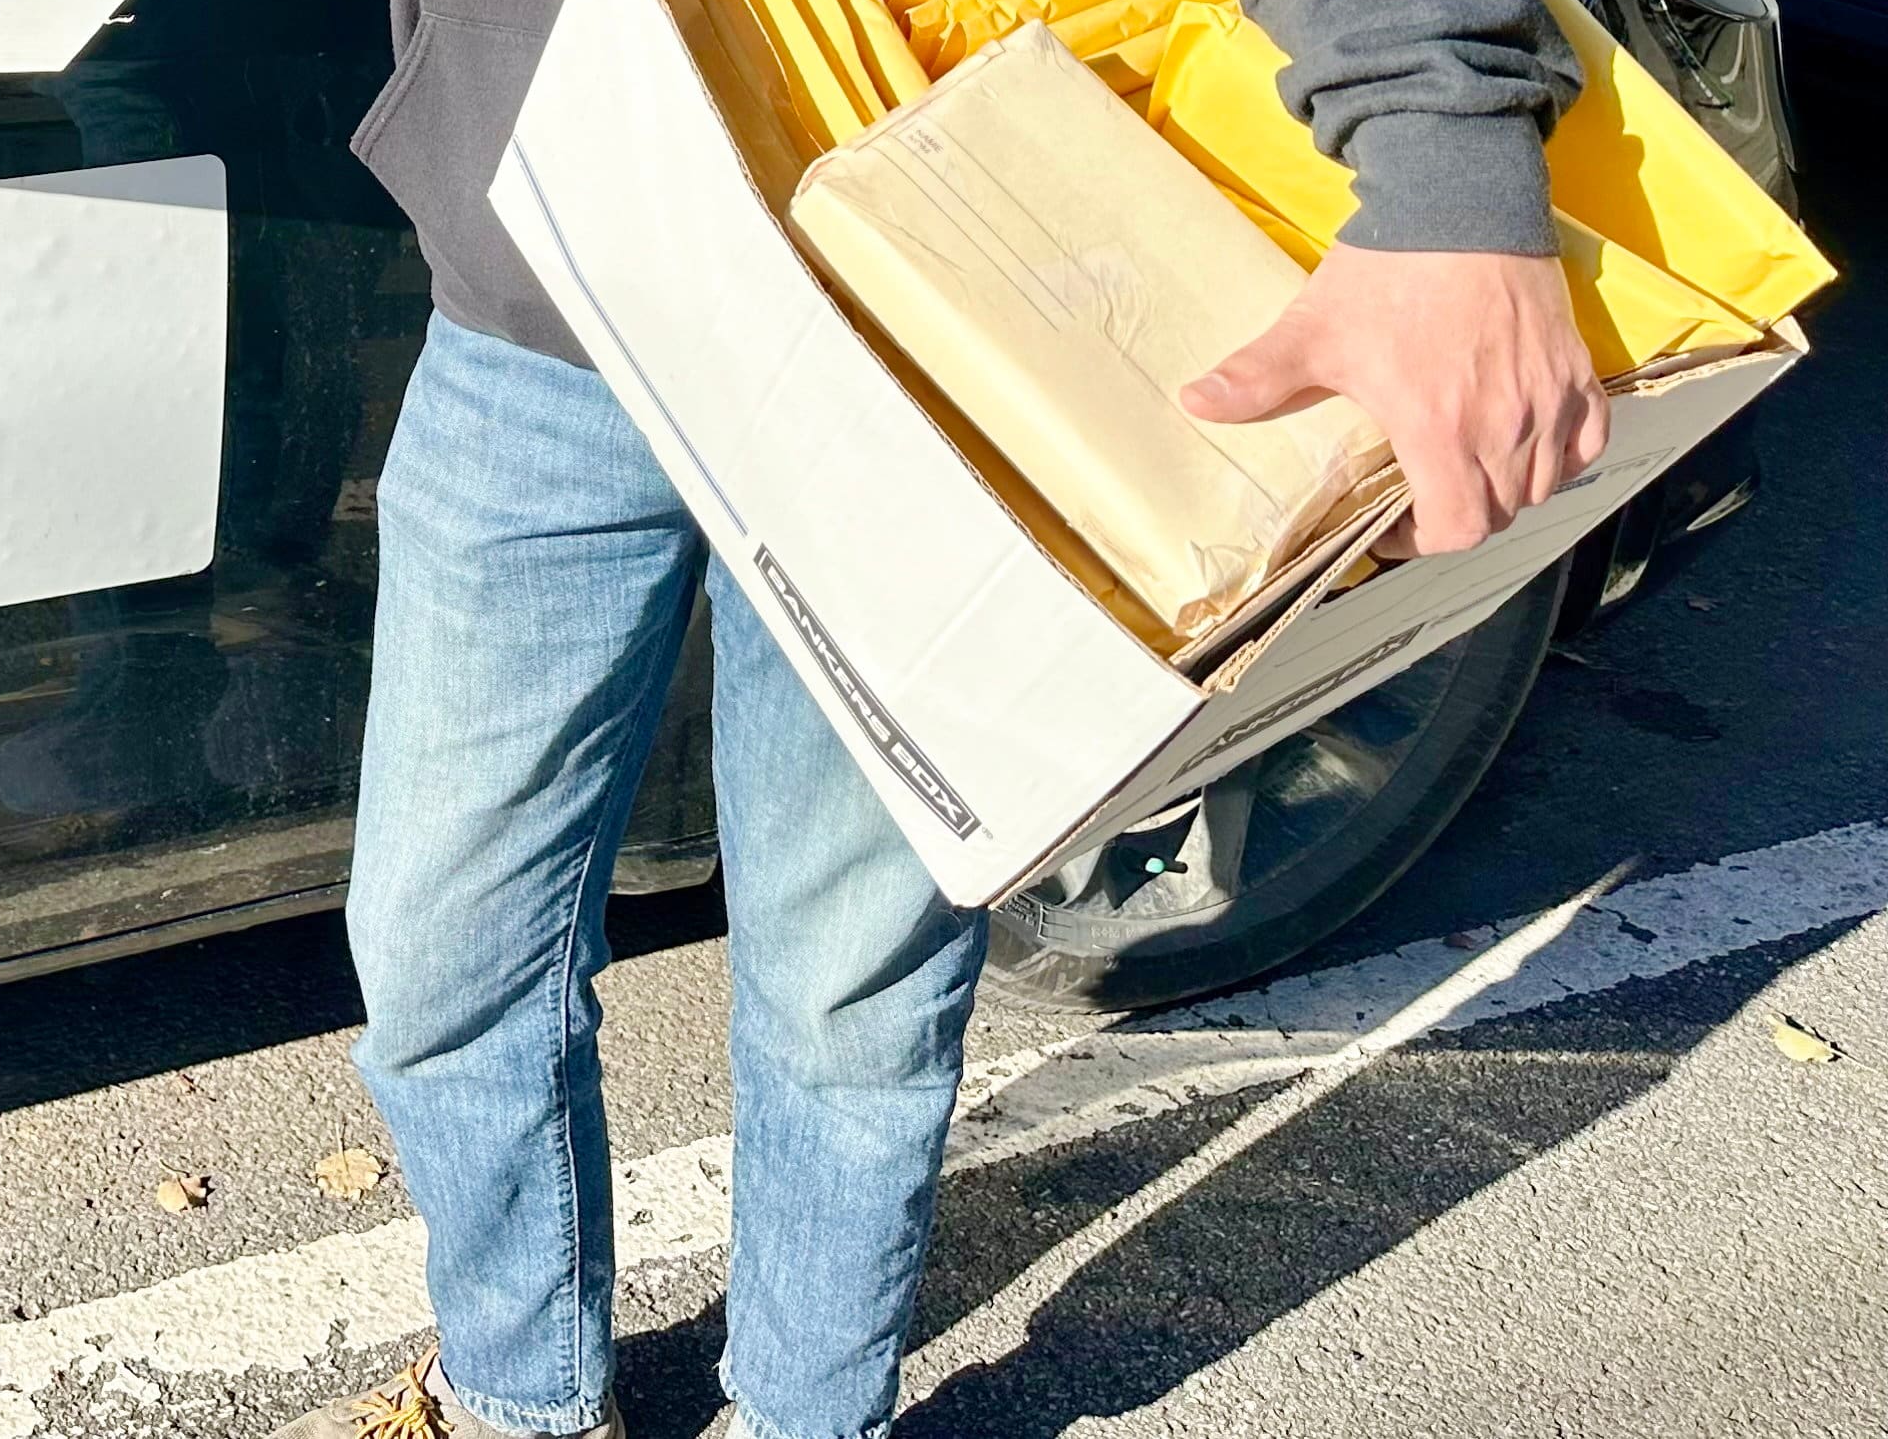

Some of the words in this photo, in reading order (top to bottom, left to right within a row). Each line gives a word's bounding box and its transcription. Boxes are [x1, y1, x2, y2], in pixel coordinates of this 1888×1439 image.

[915, 129, 944, 154] NAME
[767, 564, 892, 743] BANKERS
[890, 740, 964, 823] BOX
